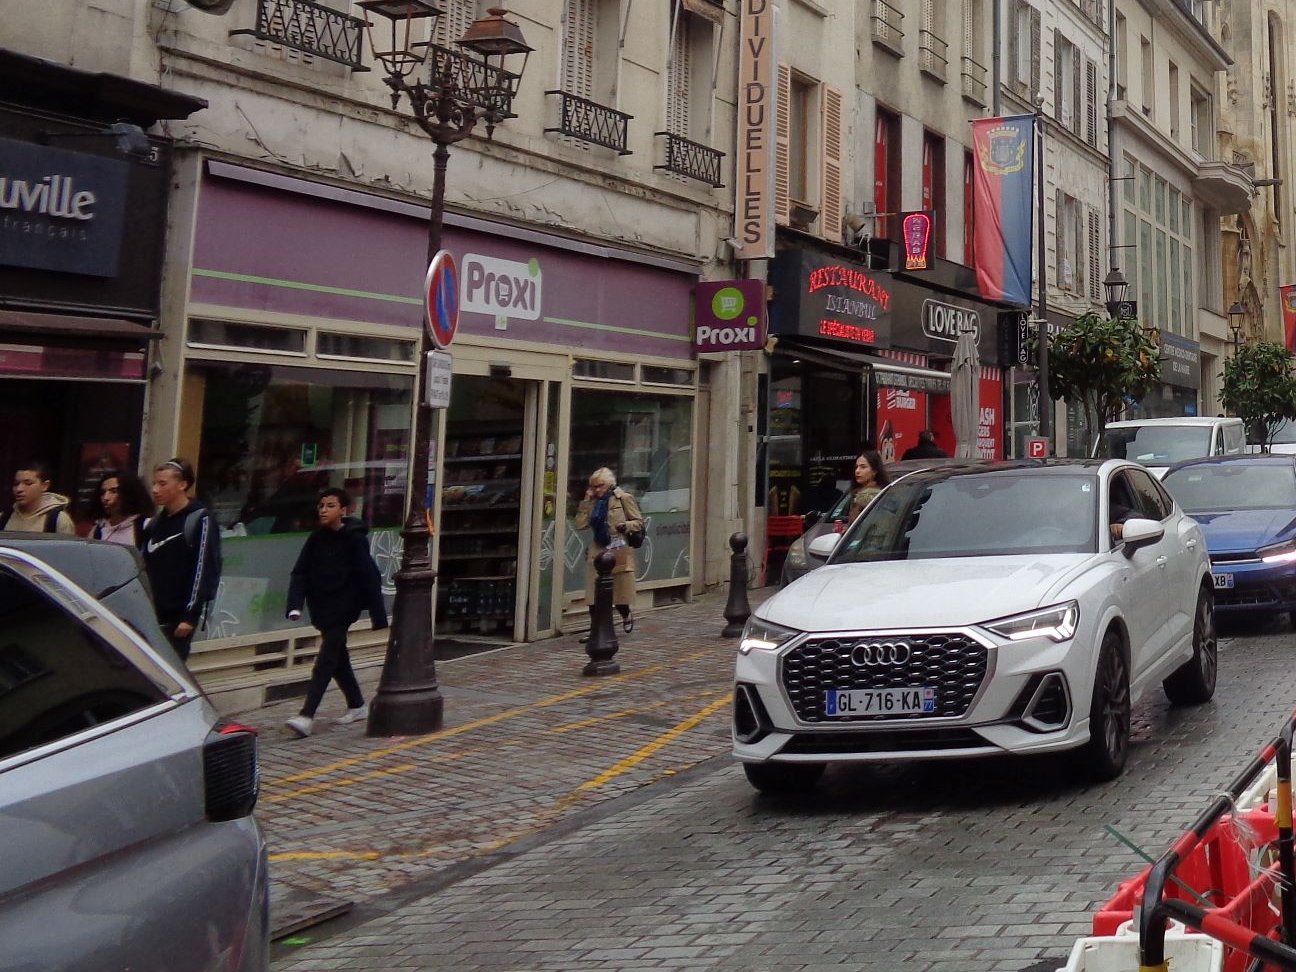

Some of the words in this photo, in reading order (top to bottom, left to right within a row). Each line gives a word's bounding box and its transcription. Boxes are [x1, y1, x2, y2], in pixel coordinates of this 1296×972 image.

[466, 258, 540, 312] Proxi
[809, 265, 891, 312] RESTAURANT
[825, 294, 877, 320] ISTANBUL
[696, 316, 758, 346] Proxi
[928, 304, 957, 335] LOVE
[957, 312, 978, 339] BAG
[1019, 313, 1027, 339] LOVE
[979, 407, 995, 426] ASH
[1033, 442, 1043, 456] P
[1214, 575, 1226, 587] XB
[838, 691, 921, 712] GL-716-KA
